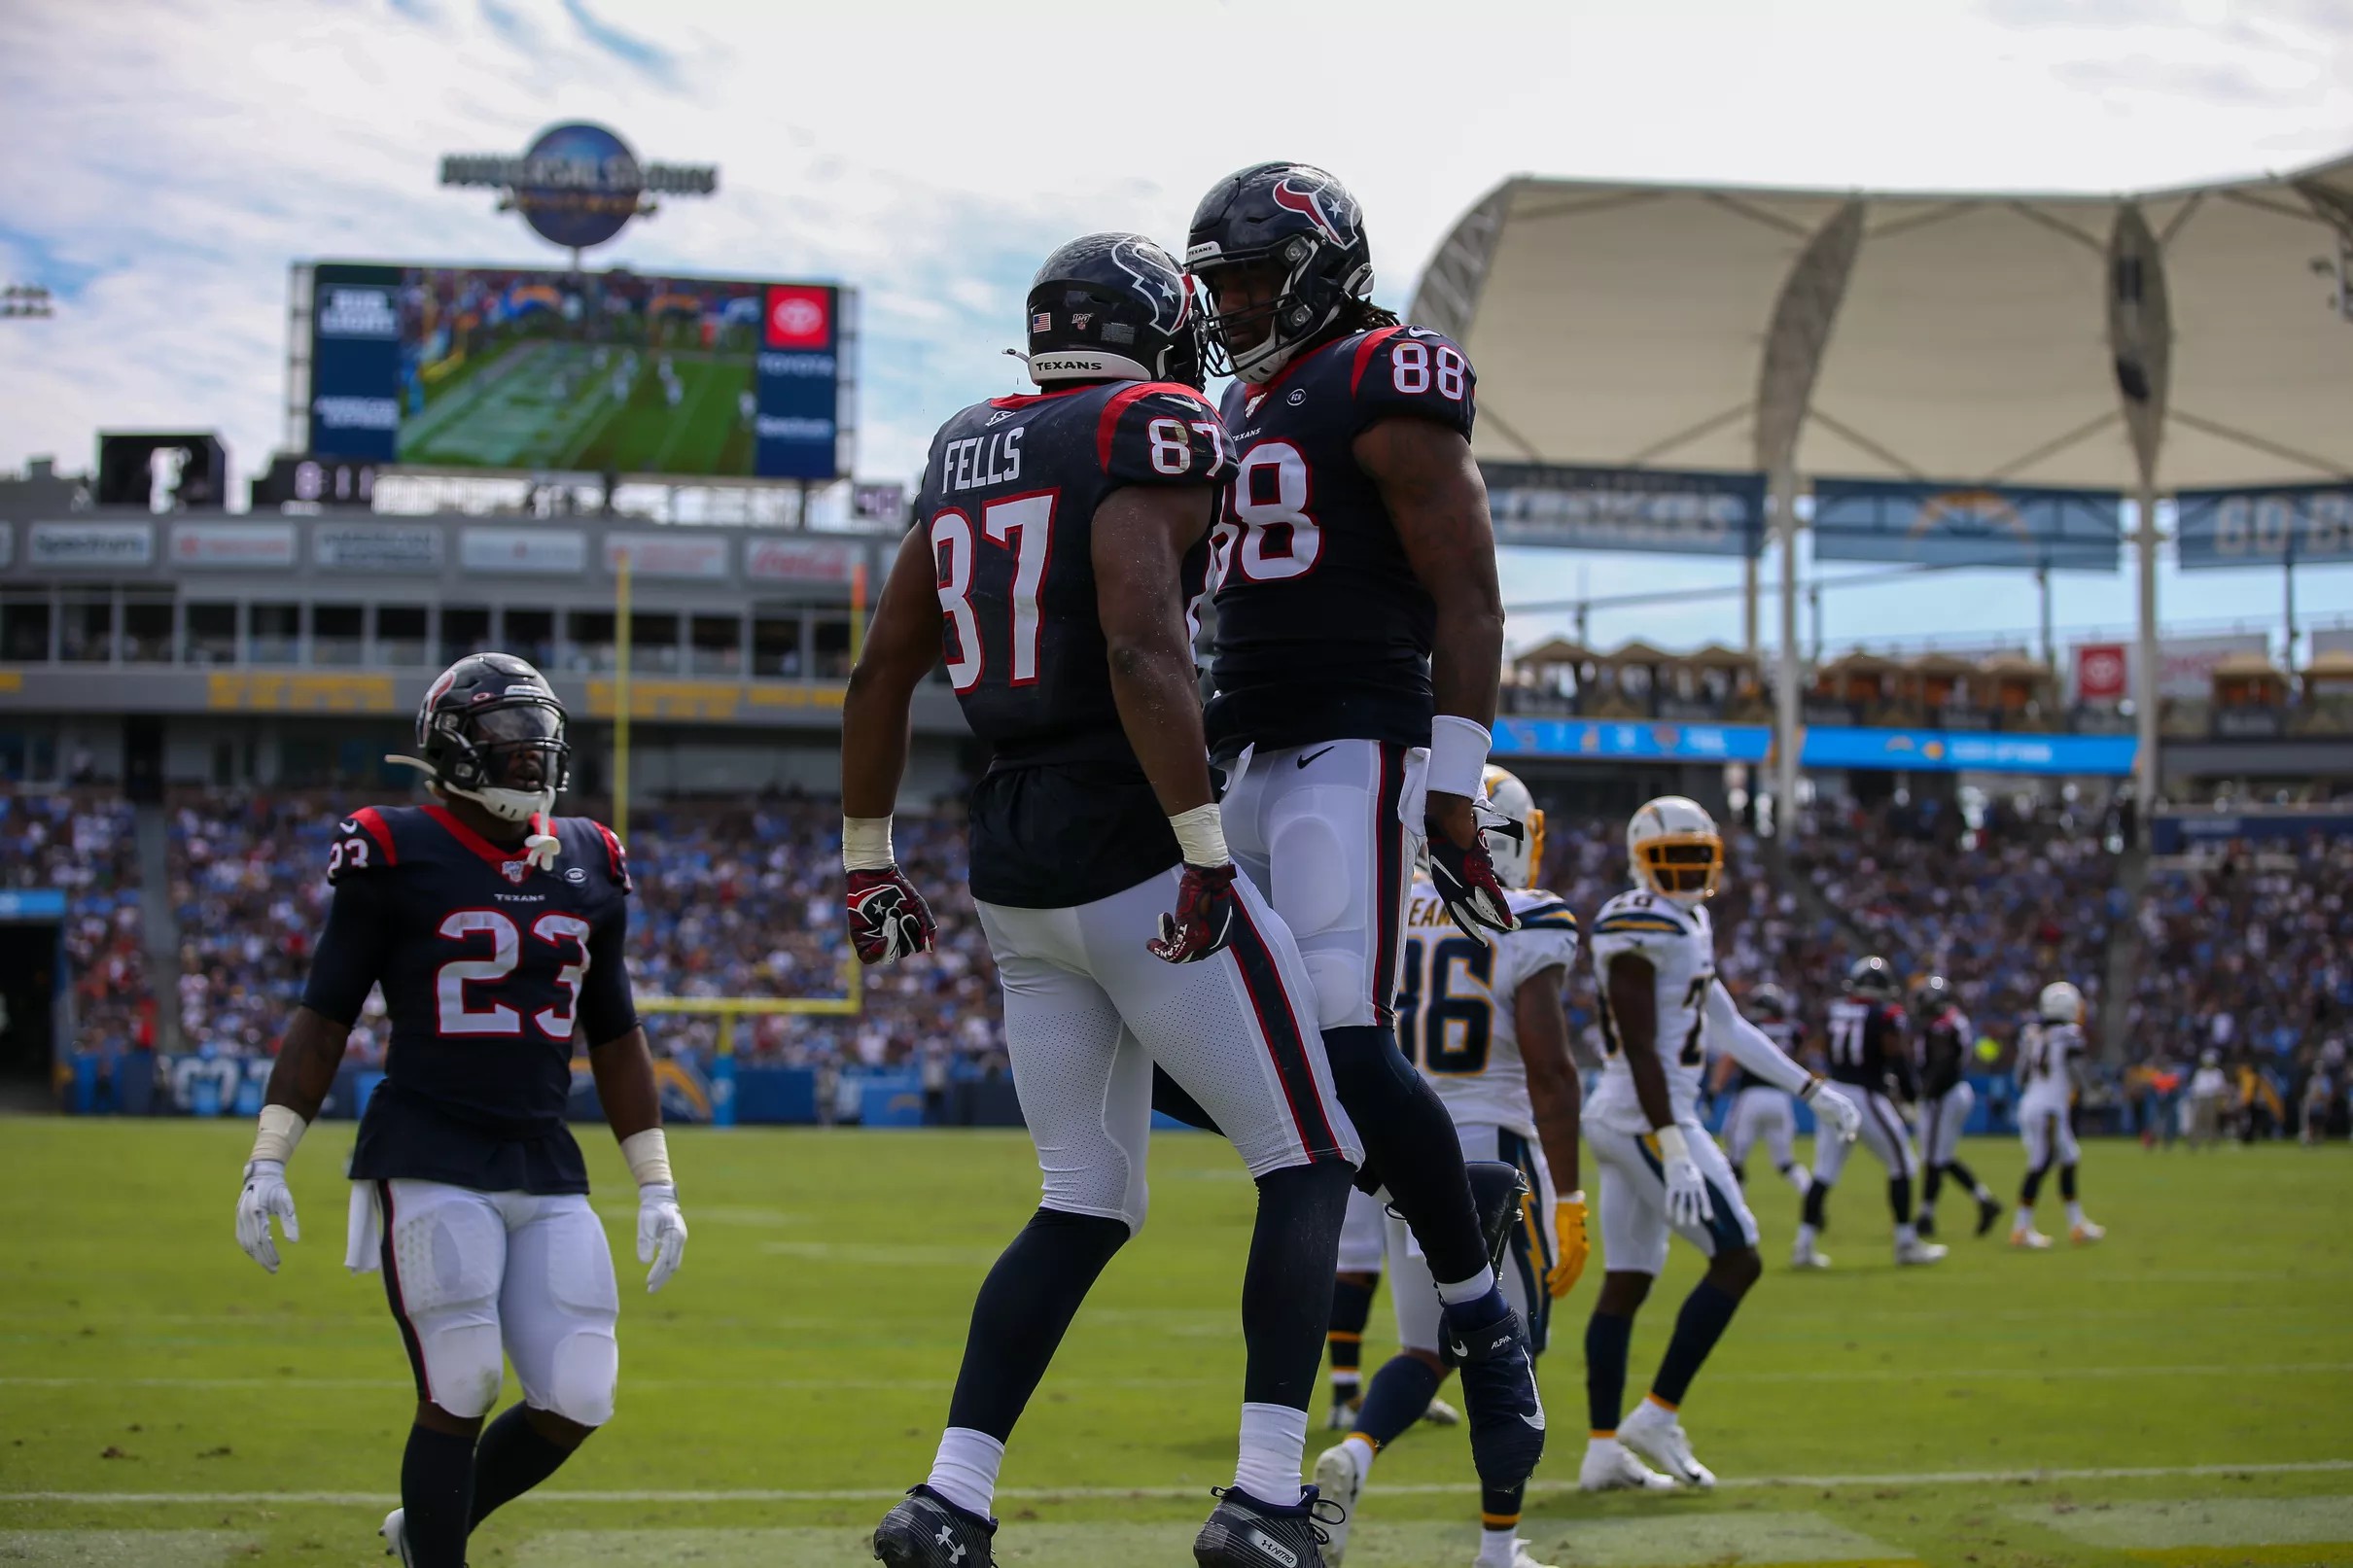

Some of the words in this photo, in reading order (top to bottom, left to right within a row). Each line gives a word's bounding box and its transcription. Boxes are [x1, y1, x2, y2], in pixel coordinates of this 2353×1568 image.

[1188, 245, 1212, 257] TEXANS
[1036, 361, 1103, 372] TEXANS
[1390, 339, 1465, 401] 88
[941, 426, 1026, 496] FELLS
[1146, 415, 1225, 480] 87
[929, 486, 1062, 696] 87
[494, 893, 545, 902] TEXANS
[433, 905, 592, 1043] 23
[1491, 1335, 1513, 1350] ALPHA
[1271, 1546, 1295, 1564] NITRO
